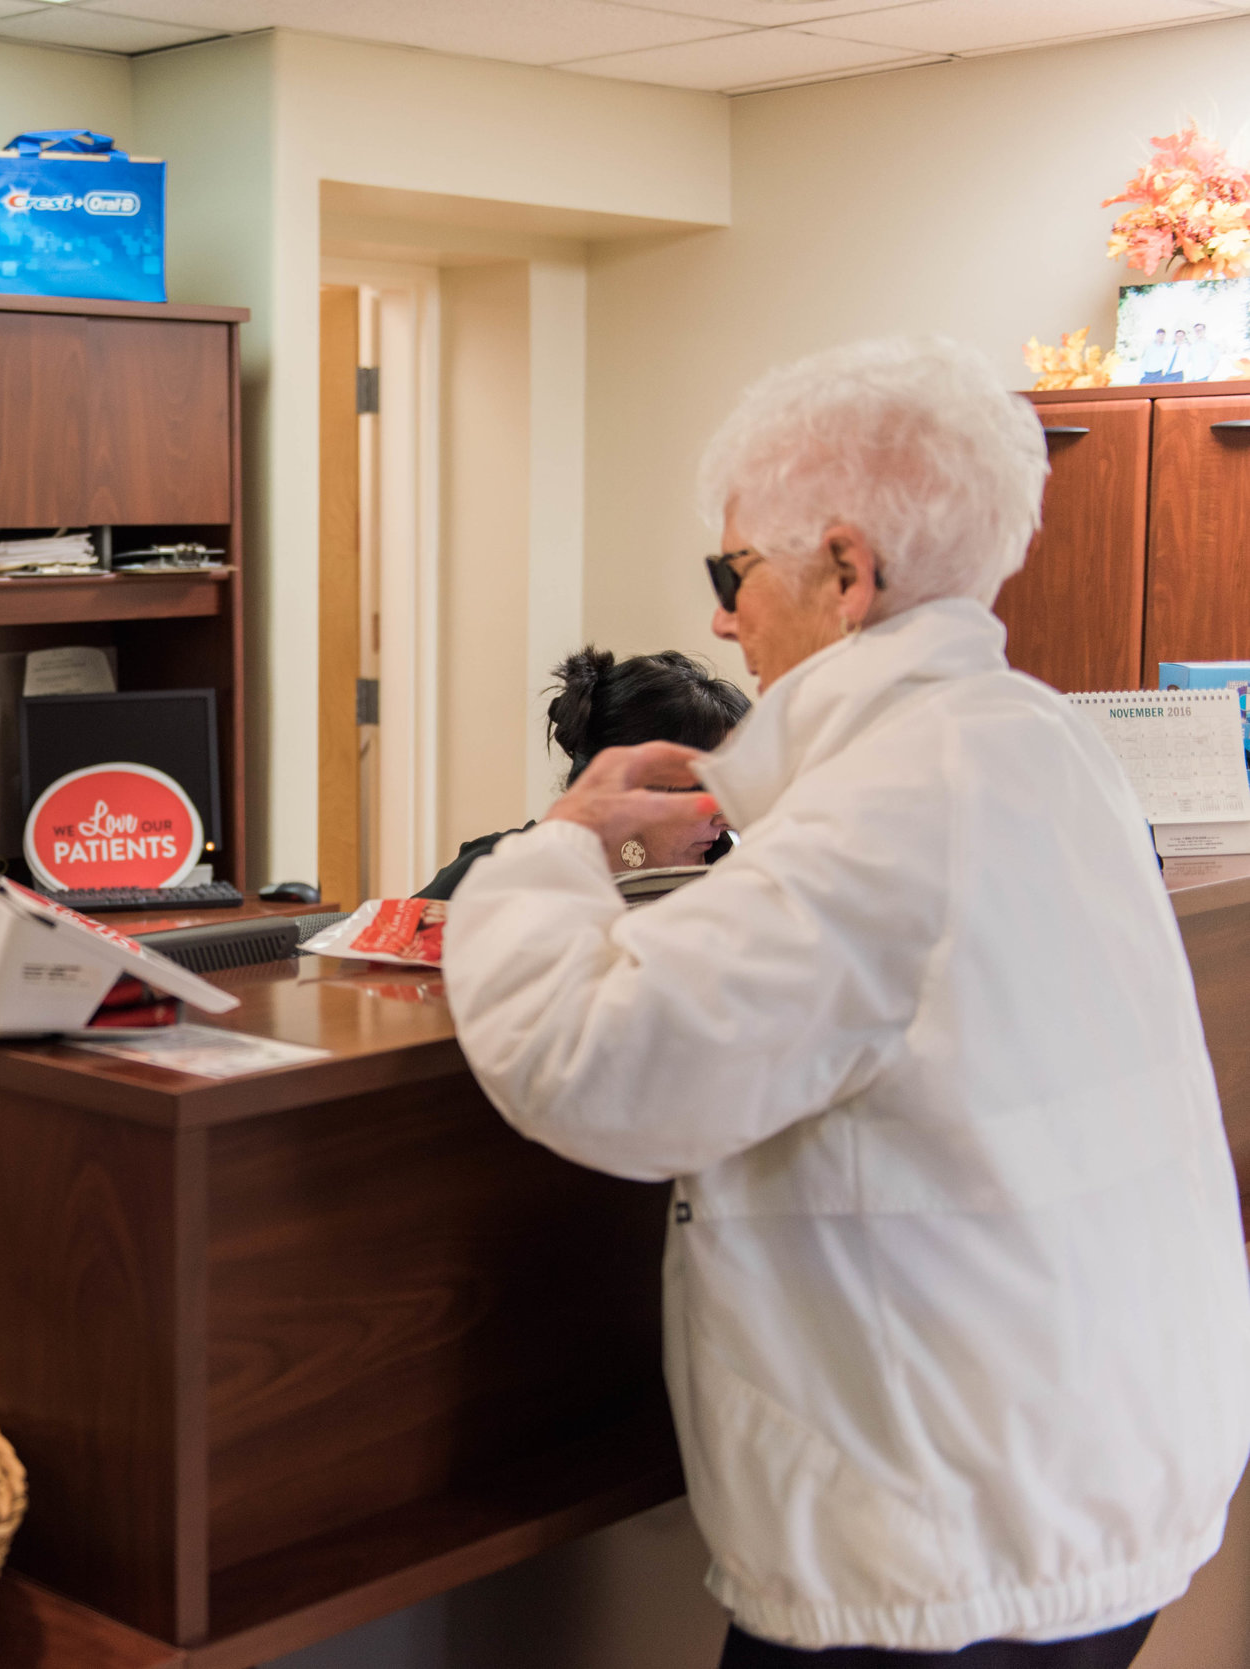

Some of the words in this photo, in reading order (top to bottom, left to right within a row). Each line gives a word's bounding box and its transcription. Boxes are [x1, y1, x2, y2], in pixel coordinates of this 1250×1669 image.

[8, 194, 73, 211] Crest
[89, 197, 135, 212] Oral-B
[1109, 707, 1164, 719] NOVEMBER
[1167, 706, 1192, 718] 2016
[53, 825, 74, 837] WE
[78, 800, 137, 838] Love
[141, 820, 172, 832] OUR
[54, 835, 177, 864] PATIENTS
